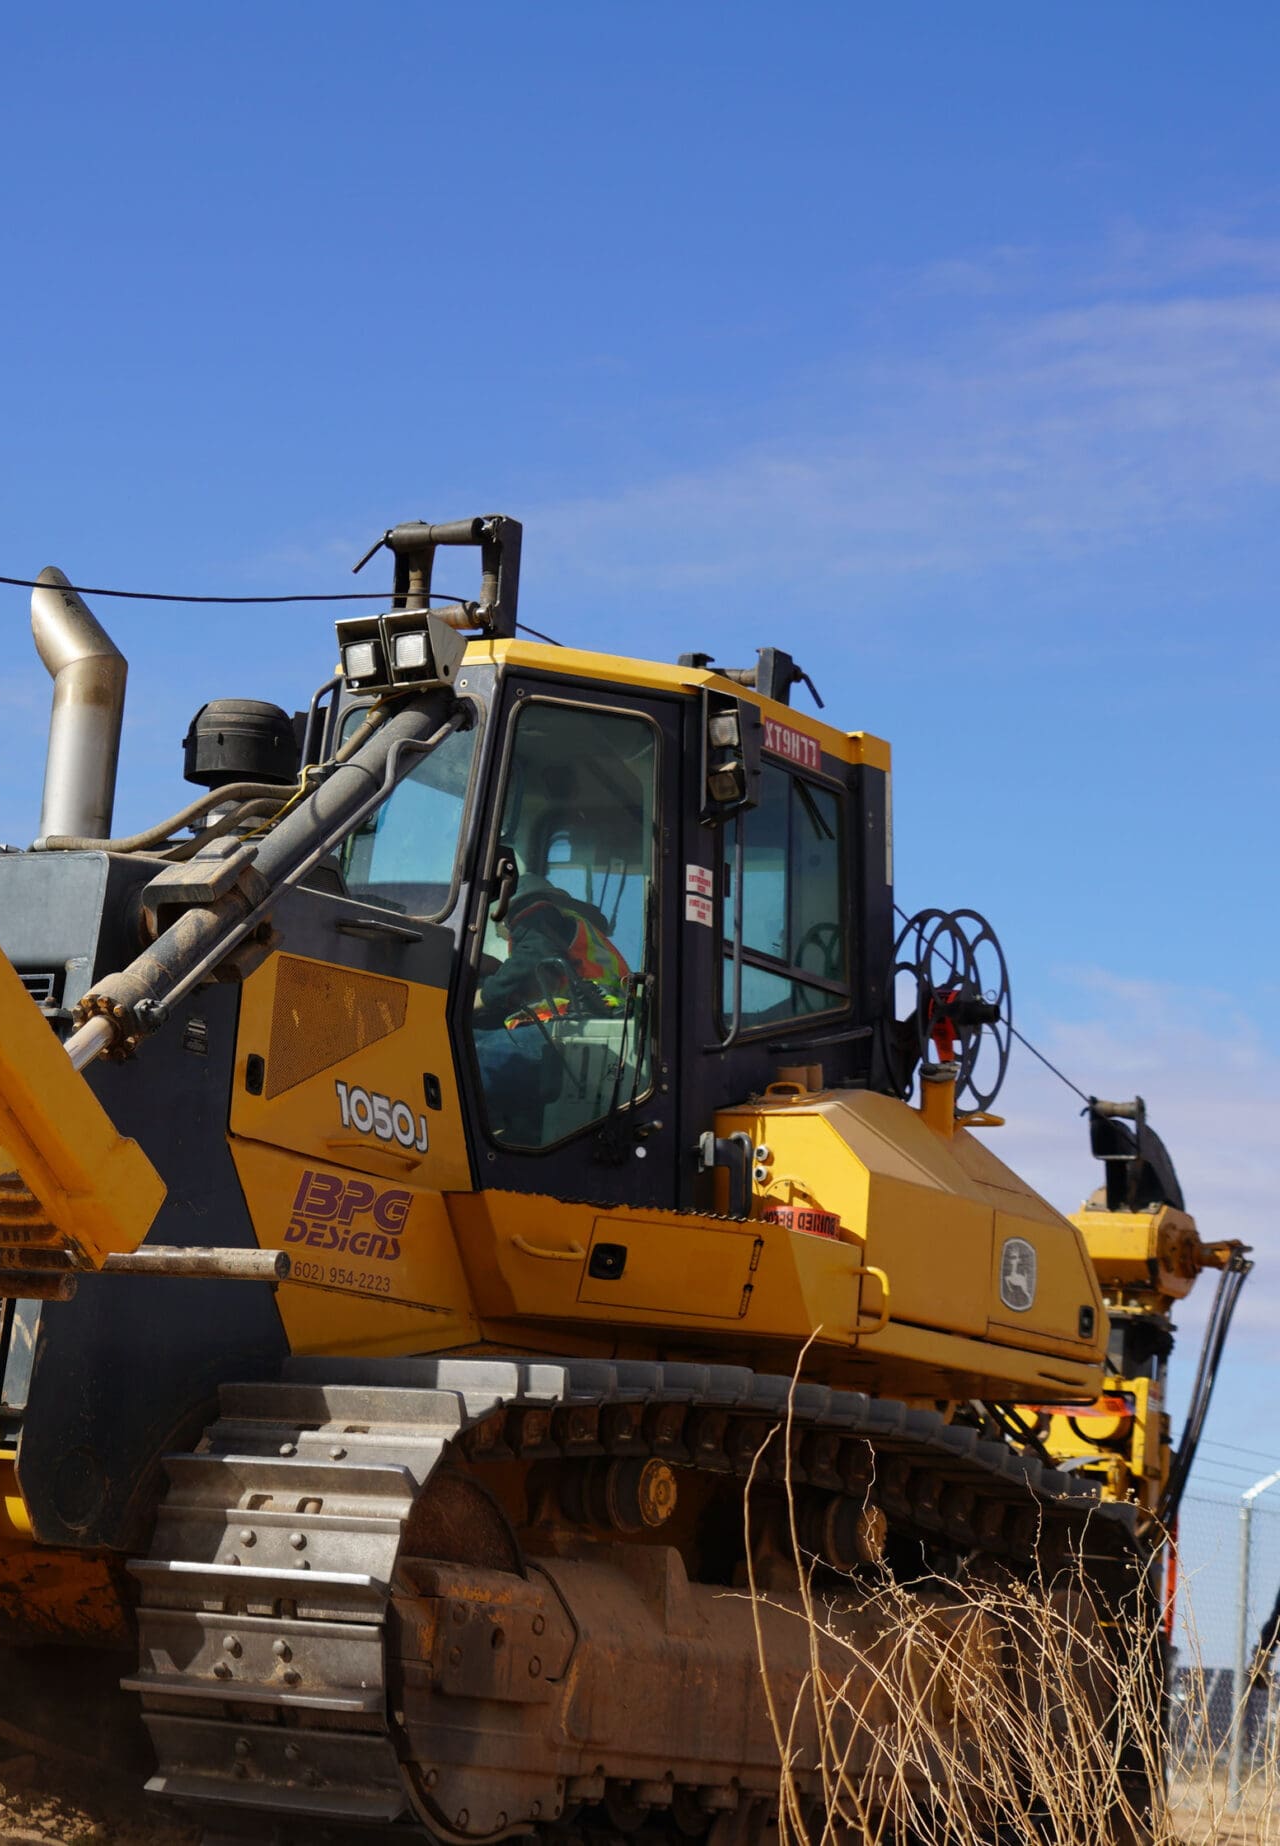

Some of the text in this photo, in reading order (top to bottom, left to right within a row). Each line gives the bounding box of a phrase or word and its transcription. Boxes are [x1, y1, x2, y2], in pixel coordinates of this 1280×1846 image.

[335, 1079, 429, 1153] 1050J
[291, 1170, 414, 1235] BPG
[294, 1261, 391, 1293] 602) 954-2223
